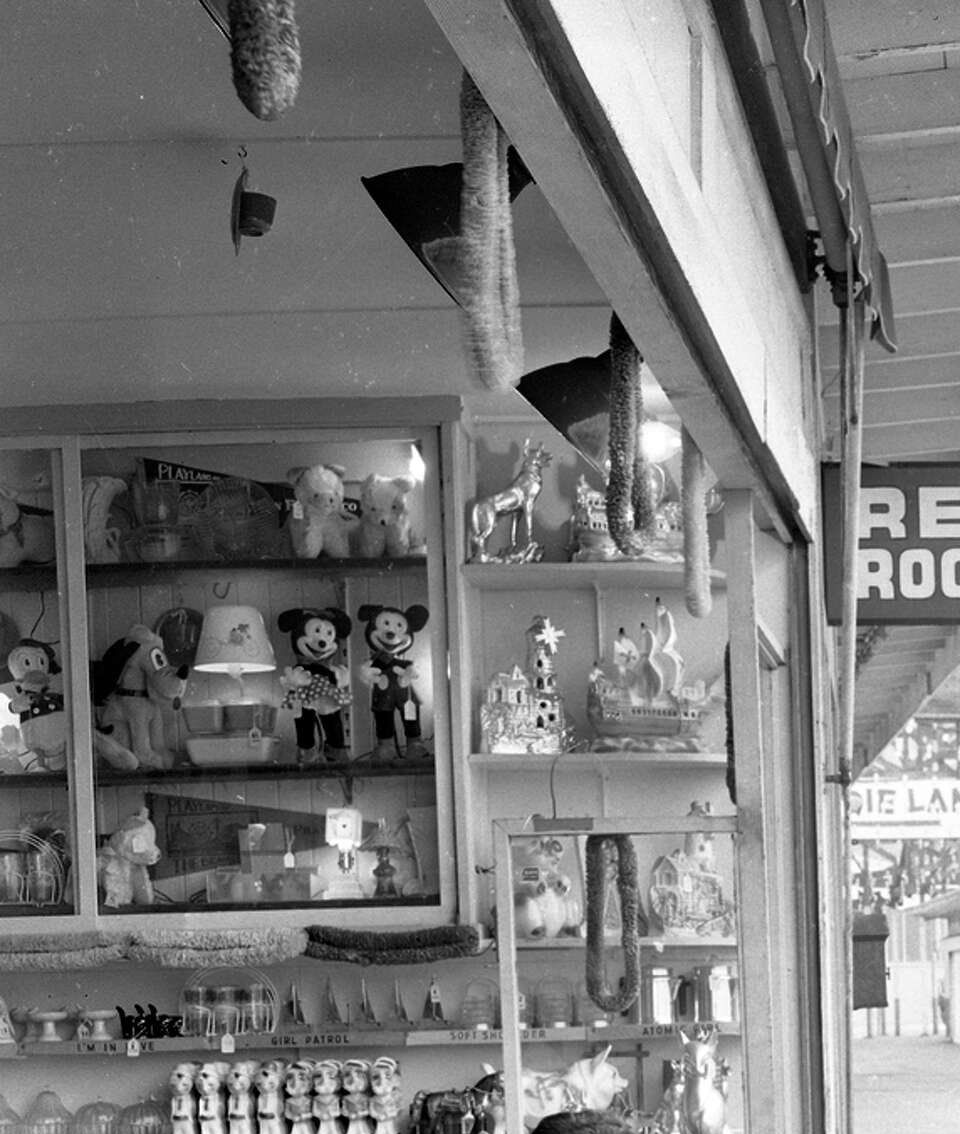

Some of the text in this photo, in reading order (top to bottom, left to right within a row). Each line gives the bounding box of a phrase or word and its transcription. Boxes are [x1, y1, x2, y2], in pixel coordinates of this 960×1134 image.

[271, 1034, 350, 1046] GIRL PATROL
[449, 1029, 546, 1041] SOFT SHODER
[103, 1042, 117, 1052] IN
[125, 1041, 154, 1052] LVE
